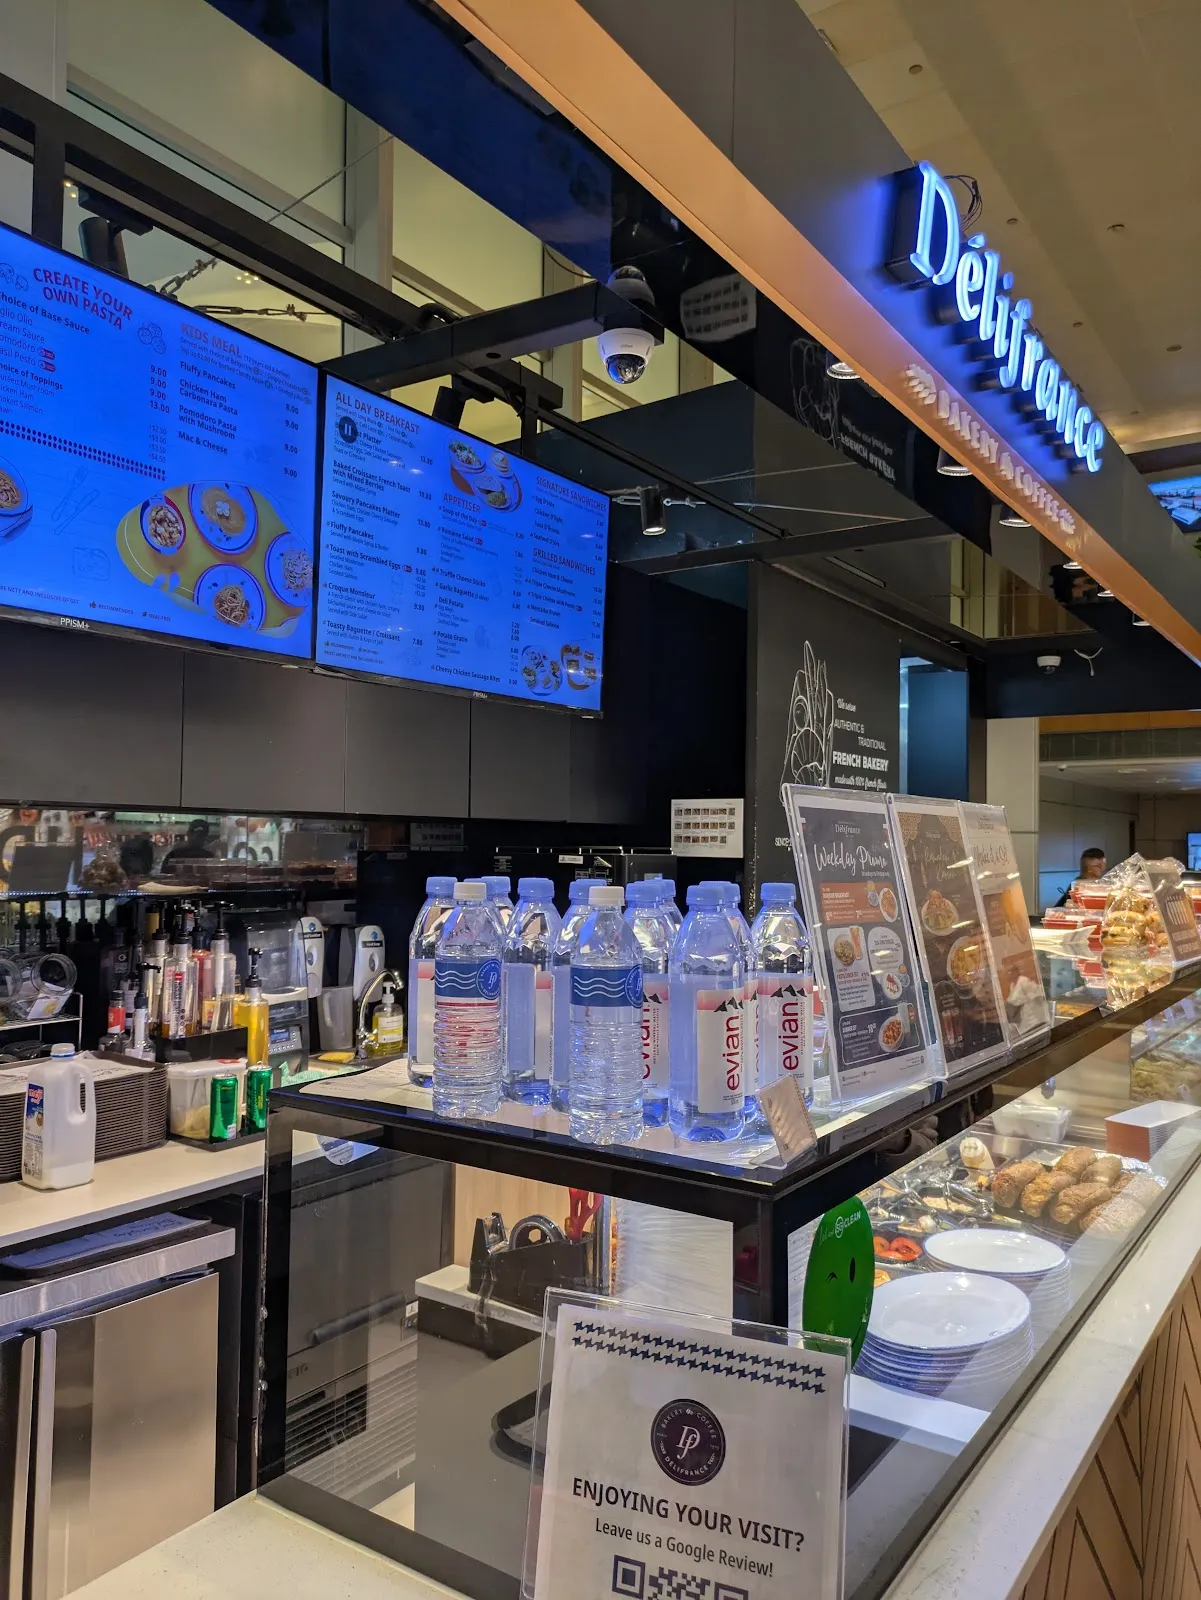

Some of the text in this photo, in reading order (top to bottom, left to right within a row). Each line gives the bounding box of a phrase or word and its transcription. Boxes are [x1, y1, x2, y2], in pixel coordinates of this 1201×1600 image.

[33, 267, 132, 321] CREATE YOUR
[0, 308, 33, 327] glio Olio
[30, 303, 39, 314] of
[41, 308, 63, 324] Base
[64, 317, 90, 335] Sauce
[43, 287, 122, 331] OWN PASTA
[910, 160, 1104, 473] Délifrance
[0, 321, 45, 344] ream Sauce
[0, 334, 35, 354] omodoro
[181, 323, 242, 360] KIDS MEAL
[15, 350, 36, 367] Pesto
[150, 364, 167, 379] 9.00
[0, 363, 64, 390] oice of Toppings
[150, 376, 167, 390] 9.00
[180, 361, 236, 390] Fluffy Pancakes
[150, 388, 167, 401] 9.00
[179, 378, 227, 404] Chicken Ham
[179, 388, 238, 417] Carbonara Pasta
[149, 400, 171, 415] 13.00
[179, 404, 238, 433] Pomodoro Pasta
[336, 391, 353, 407] ALL
[354, 399, 372, 416] DAY
[374, 407, 421, 436] BREAKFAST
[178, 414, 236, 441] with Mushroom
[363, 432, 382, 446] Platter
[178, 430, 228, 455] Mac & Cheese
[937, 389, 998, 464] BAKERY
[1014, 466, 1059, 522] COFFEE
[333, 459, 412, 495] Baked Croissant French Toast
[333, 468, 385, 493] with Mixed Berries
[536, 476, 570, 498] SIGNATURE
[332, 490, 401, 520] Savoury Pancakes Platter
[443, 493, 481, 514] APPETISER
[330, 521, 374, 542] Fluffy Pancakes
[330, 544, 401, 571] Toast with Scrambled Eggs
[533, 548, 558, 563] GRILLED
[559, 556, 596, 577] SANDWICHES
[328, 582, 376, 600] Croque Monsieur
[327, 620, 346, 632] Toasty
[346, 624, 372, 636] Baguette
[376, 630, 401, 643] Croissant
[834, 718, 860, 734] AUTHENTIC
[857, 736, 887, 752] TRADITIONAL
[832, 750, 889, 772] FRENCH BAKERY
[813, 842, 888, 876] Weekday Promo
[777, 1002, 799, 1071] evian
[722, 1015, 740, 1091] evian
[844, 1210, 861, 1229] CLEAN
[661, 1408, 718, 1440] BAKERY COFFEE
[572, 1477, 805, 1552] ENJOYING YOUR VISIT?
[595, 1517, 773, 1578] Leave us a Google Review!
